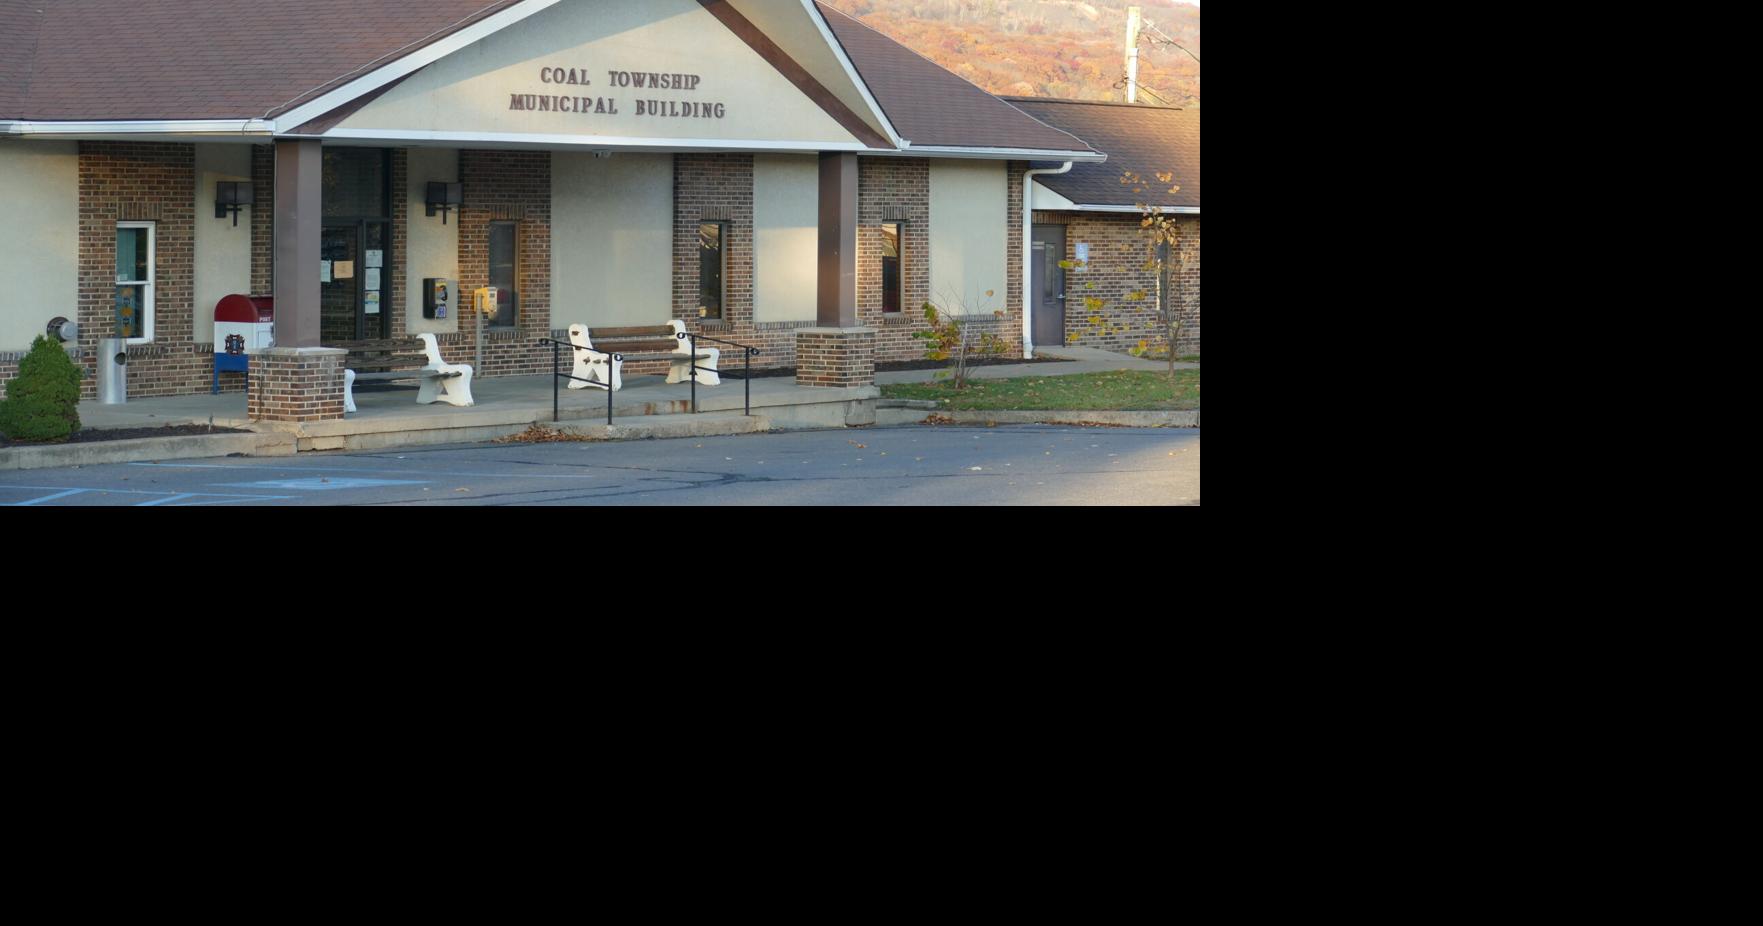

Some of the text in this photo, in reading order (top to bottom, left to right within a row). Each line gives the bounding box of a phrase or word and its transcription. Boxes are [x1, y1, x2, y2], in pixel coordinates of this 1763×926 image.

[540, 67, 700, 90] COAL TOWNSHIP
[509, 93, 726, 119] MUNICIPAL BUILDING
